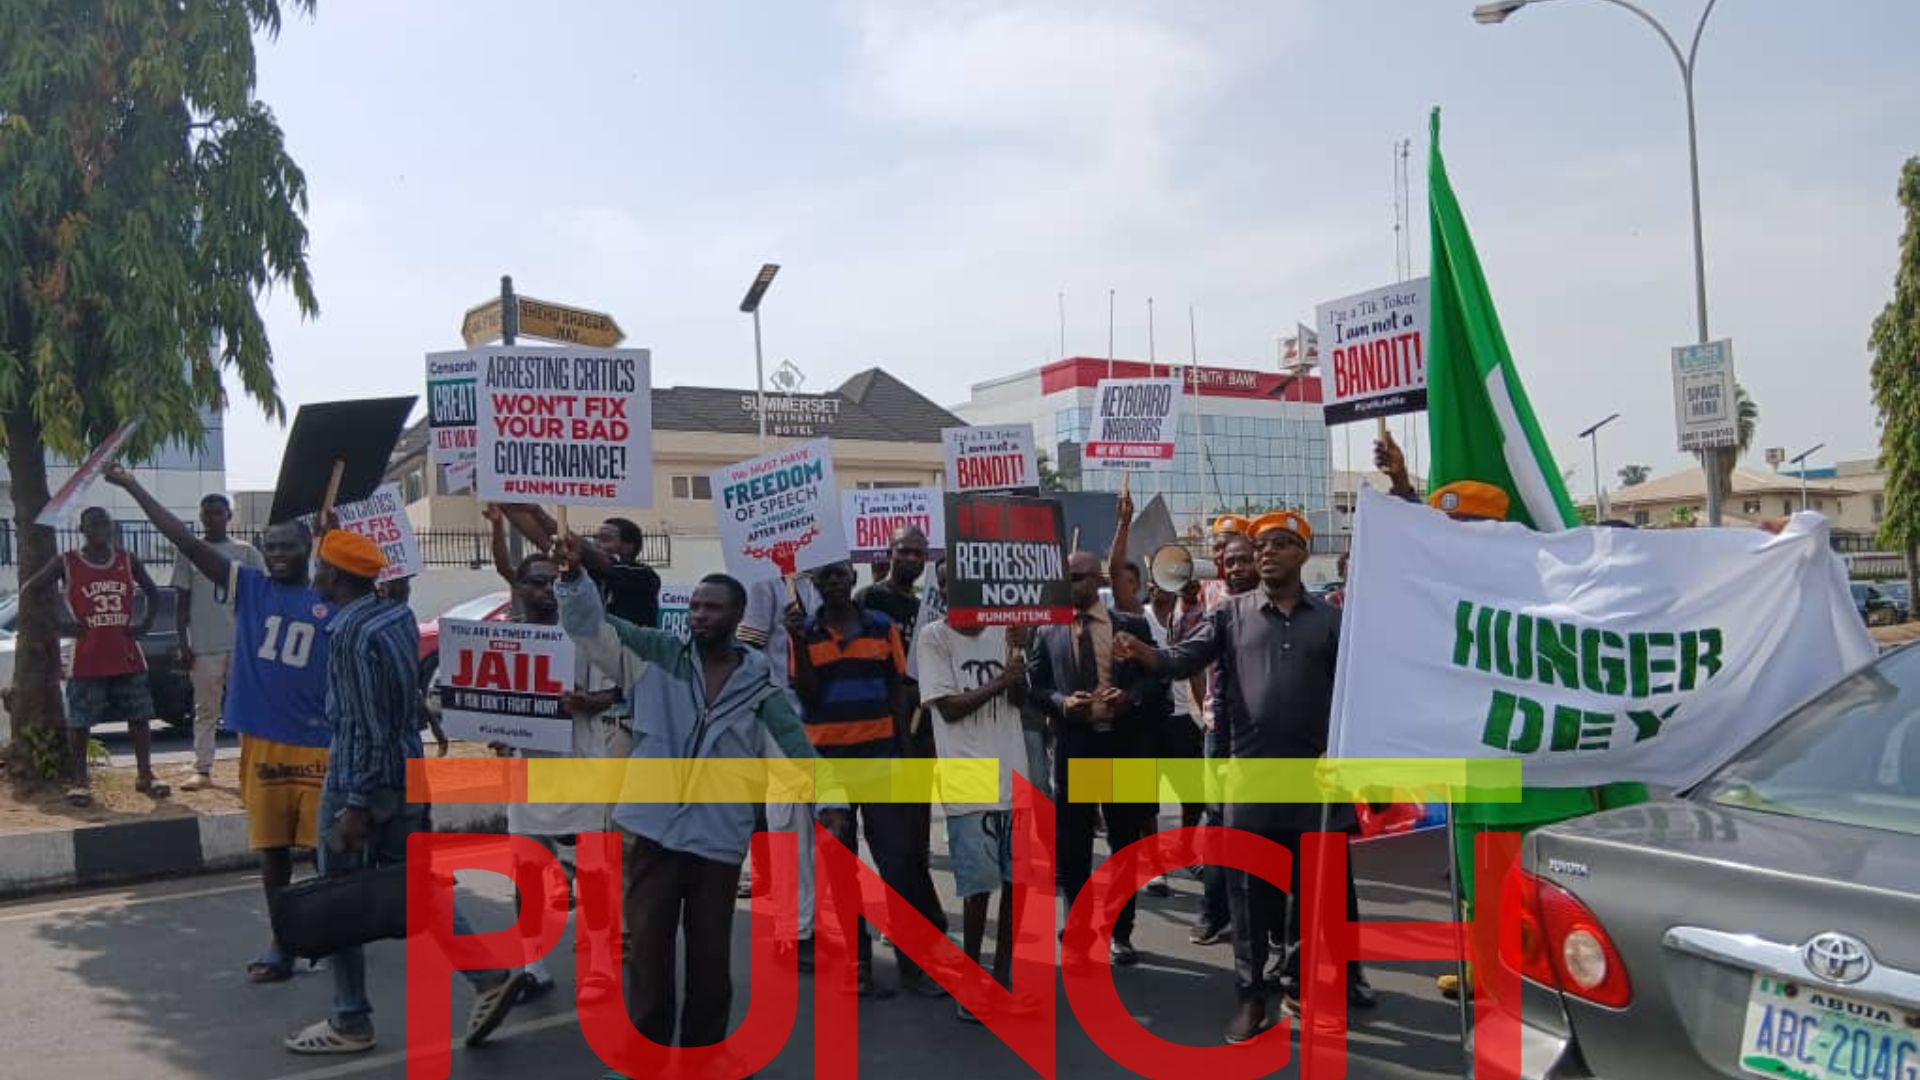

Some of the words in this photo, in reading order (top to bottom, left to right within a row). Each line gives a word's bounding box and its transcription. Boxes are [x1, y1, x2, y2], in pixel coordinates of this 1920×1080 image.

[1335, 323, 1343, 343] I
[1345, 324, 1369, 339] am
[1372, 311, 1398, 333] not
[1403, 313, 1413, 327] a
[486, 355, 570, 389] ARRESTING
[573, 358, 635, 393] CRITICS
[1187, 369, 1224, 386] ZENITH
[1228, 371, 1257, 389] BANK
[1333, 330, 1423, 398] BANDIT!
[434, 384, 476, 423] CREAT
[491, 394, 577, 417] WON'T
[584, 397, 628, 419] FIX
[1101, 384, 1172, 417] KEYBOARD
[493, 416, 564, 439] YOUR
[571, 418, 629, 442] BAD
[774, 425, 814, 435] HOTEL
[1102, 417, 1162, 442] WARRIORS
[494, 441, 626, 480] GOVERNANCE!
[957, 453, 1024, 489] BANDIT!
[504, 480, 617, 498] #UNMUTEME
[723, 459, 823, 510] FREEDOM
[735, 504, 755, 523] OF
[760, 485, 818, 516] SPEECH
[868, 504, 889, 514] am
[892, 501, 913, 513] not
[955, 541, 1063, 580] REPRESSION
[81, 580, 127, 598] LOWER
[93, 594, 122, 613] 33
[981, 583, 1043, 606] NOW
[257, 615, 316, 669] 10
[473, 626, 490, 637] ARE
[492, 628, 500, 638] A
[501, 628, 532, 639] TWEET
[535, 630, 563, 641] AWAY
[1452, 600, 1723, 698] HUNGER
[451, 649, 564, 695] JAIL
[1481, 688, 1682, 754] DEY
[1756, 1003, 1919, 1080] ABC-204G
